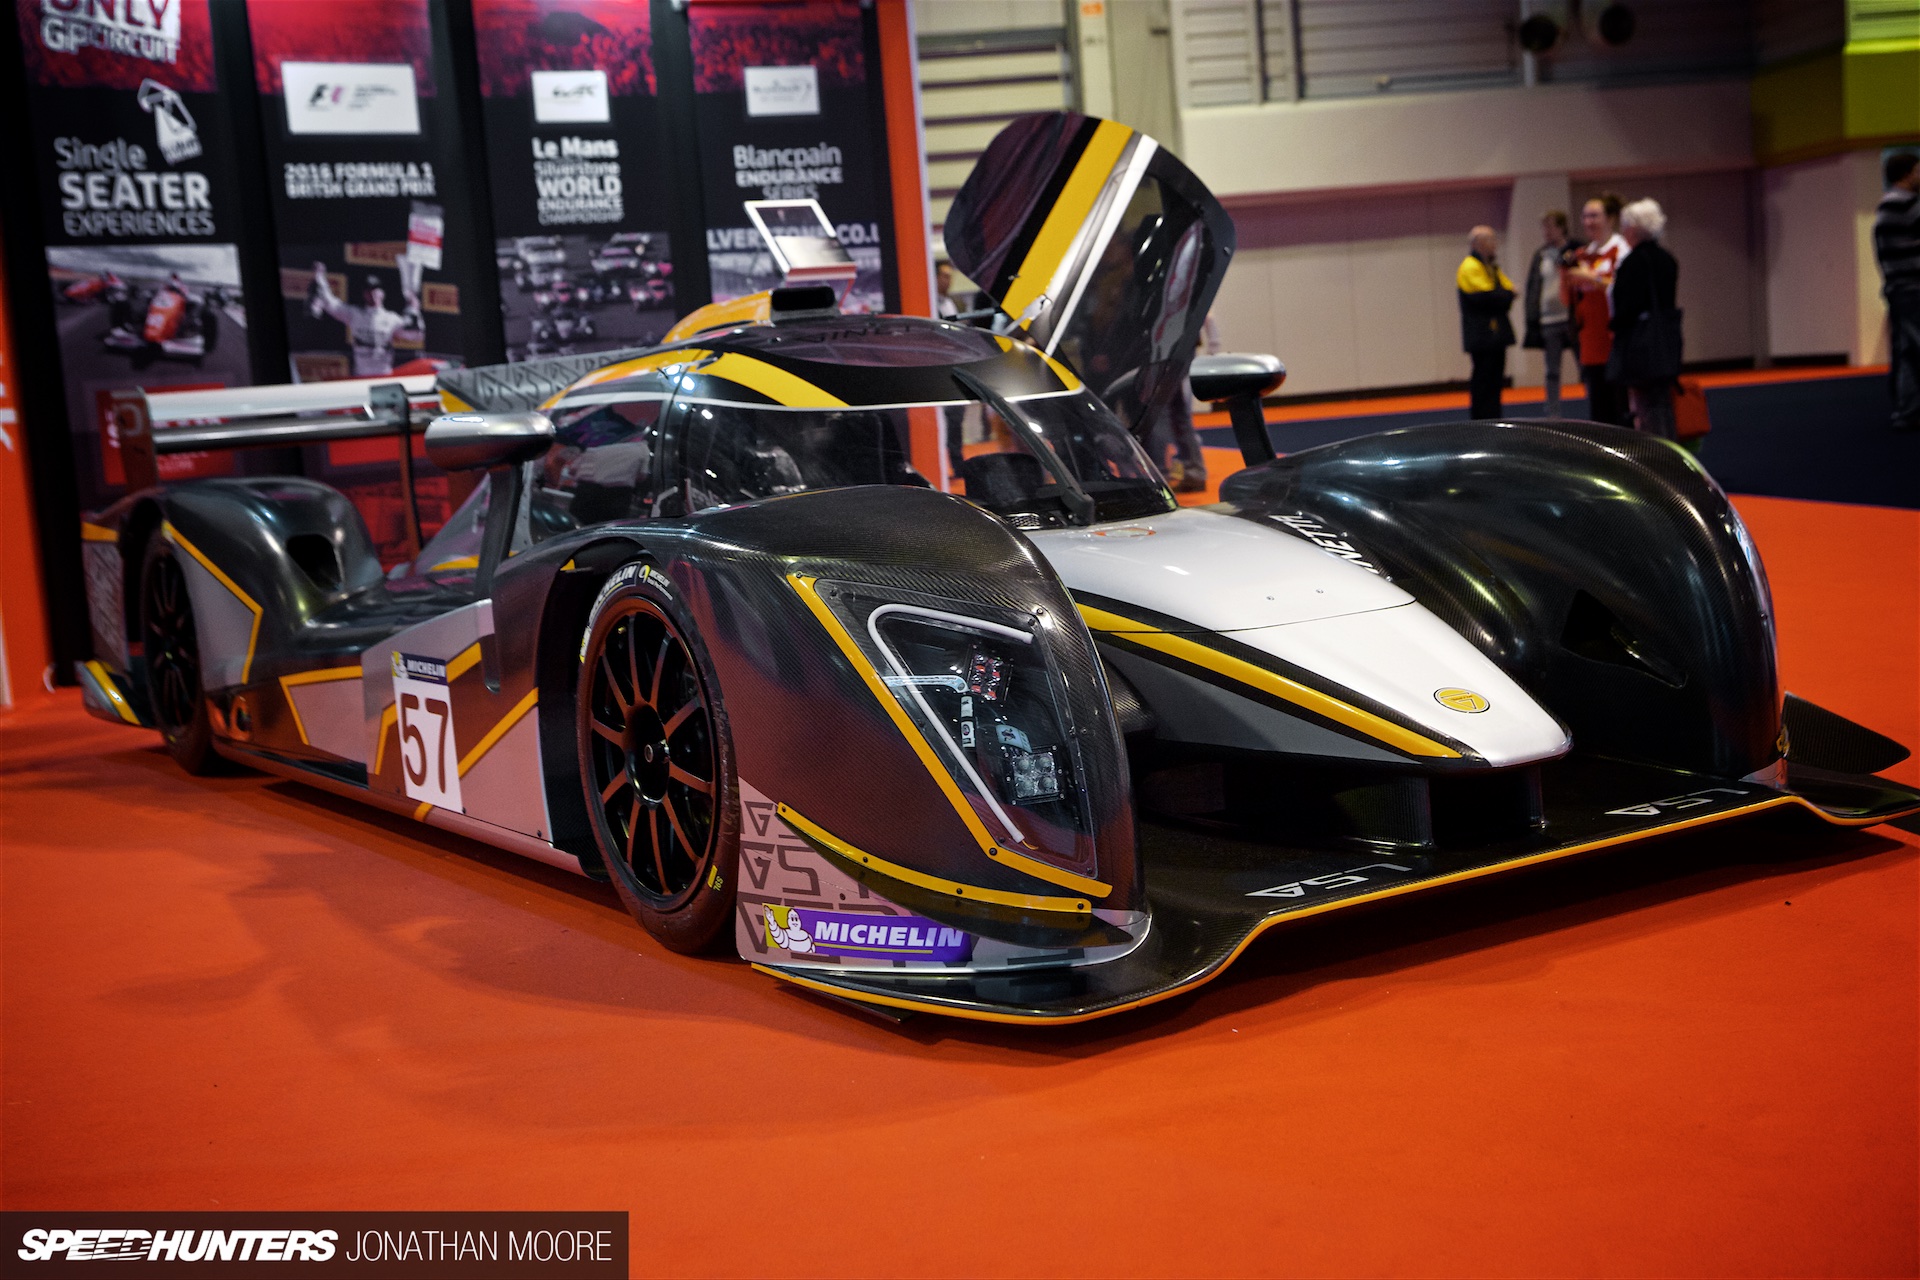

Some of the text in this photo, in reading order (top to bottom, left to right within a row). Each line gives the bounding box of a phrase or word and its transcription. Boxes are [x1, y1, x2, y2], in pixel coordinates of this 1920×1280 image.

[53, 136, 147, 178] Single
[532, 136, 619, 159] Le Mans
[733, 142, 842, 169] Blancpain
[536, 175, 623, 198] WORLD
[736, 167, 843, 187] ENDURANCE
[58, 171, 213, 211] SEATER
[63, 210, 217, 238] EXPERIENCES
[407, 659, 446, 678] MICHELIN
[401, 692, 449, 795] 57
[814, 920, 965, 948] MICHELIN
